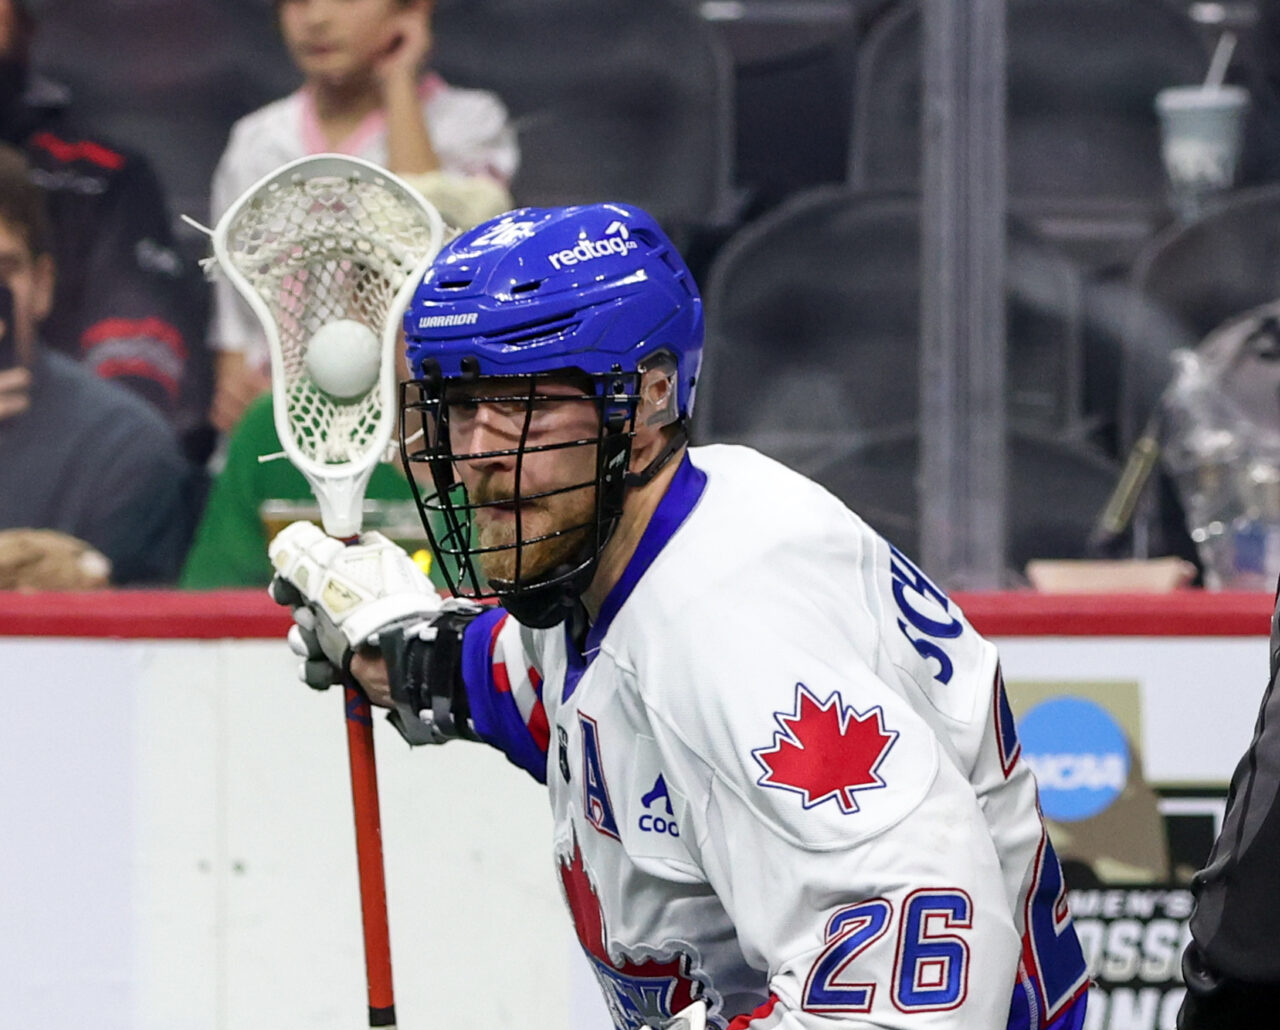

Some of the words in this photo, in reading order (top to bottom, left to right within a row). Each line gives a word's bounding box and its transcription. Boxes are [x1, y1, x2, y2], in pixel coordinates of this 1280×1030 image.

[418, 312, 479, 328] WARRIOR
[577, 709, 623, 844] A
[803, 888, 974, 1014] 26
